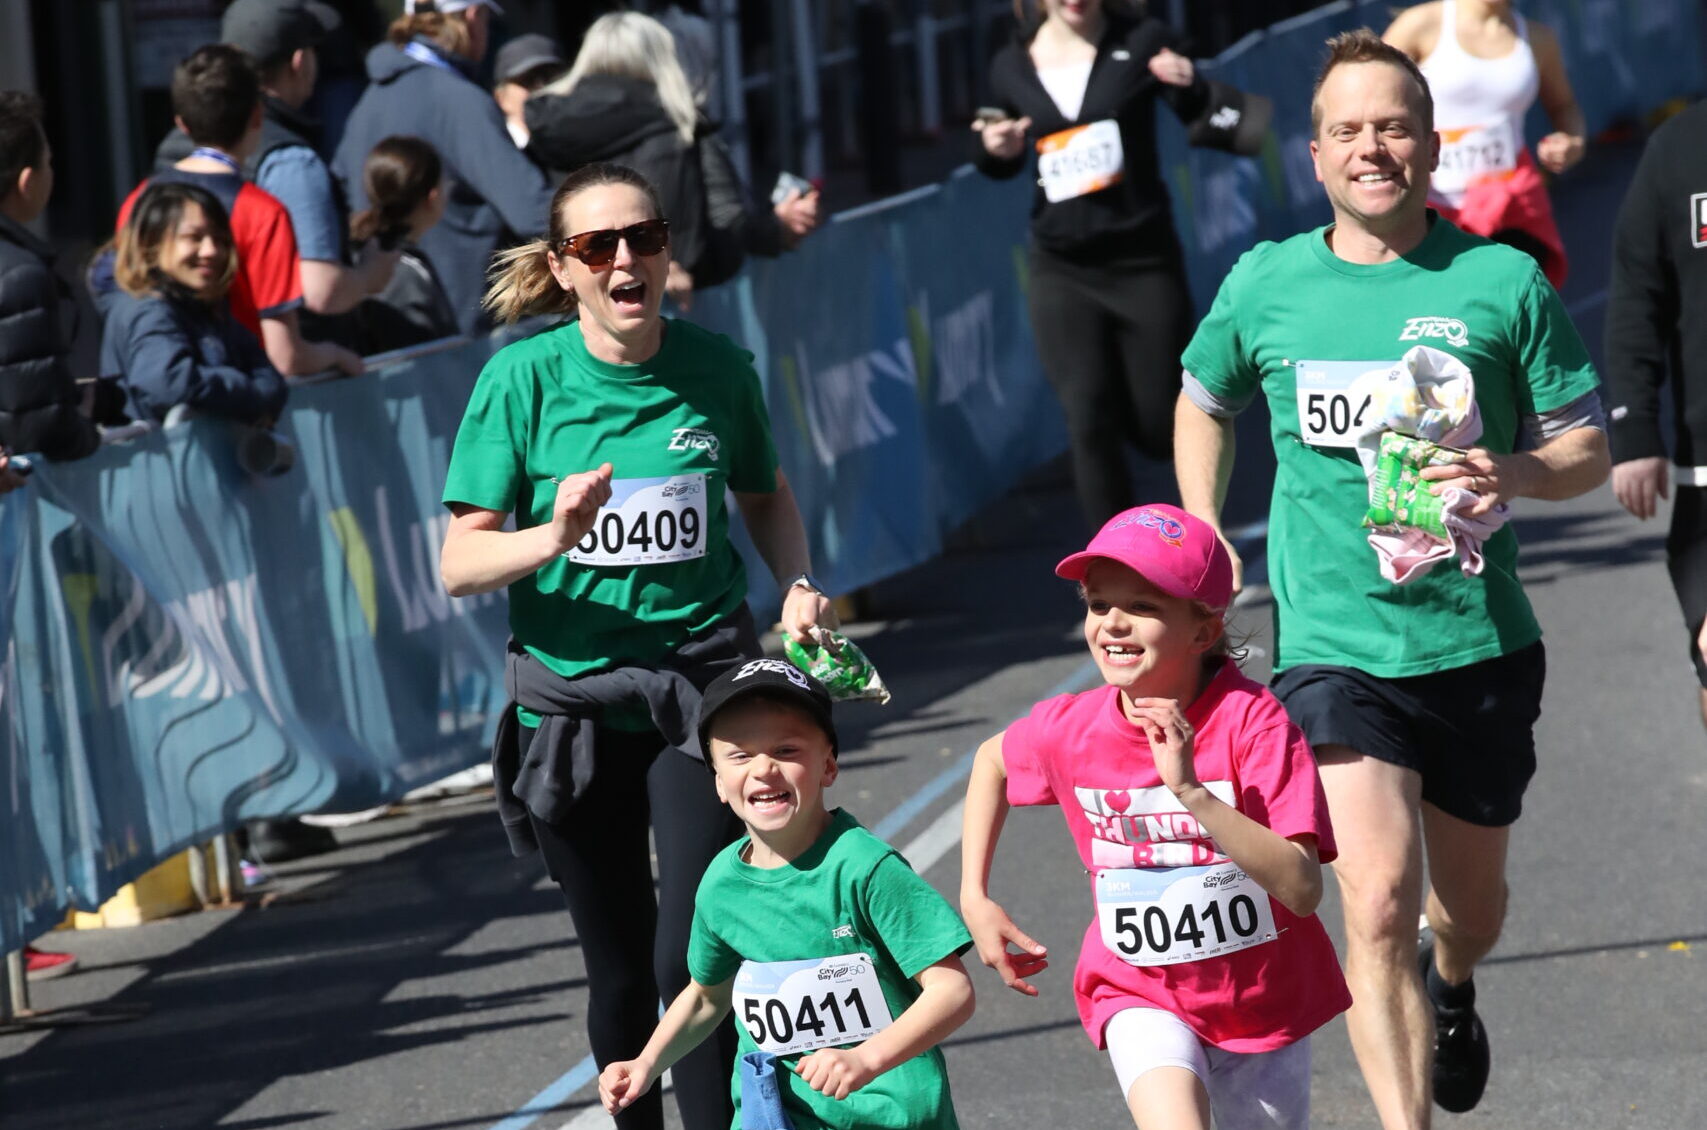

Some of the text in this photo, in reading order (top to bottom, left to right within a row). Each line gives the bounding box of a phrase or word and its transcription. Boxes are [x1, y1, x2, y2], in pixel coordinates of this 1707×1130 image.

[1205, 875, 1222, 884] City
[1115, 894, 1259, 955] 50410
[819, 968, 835, 976] City
[849, 964, 866, 976] 50
[744, 987, 872, 1045] 50411
